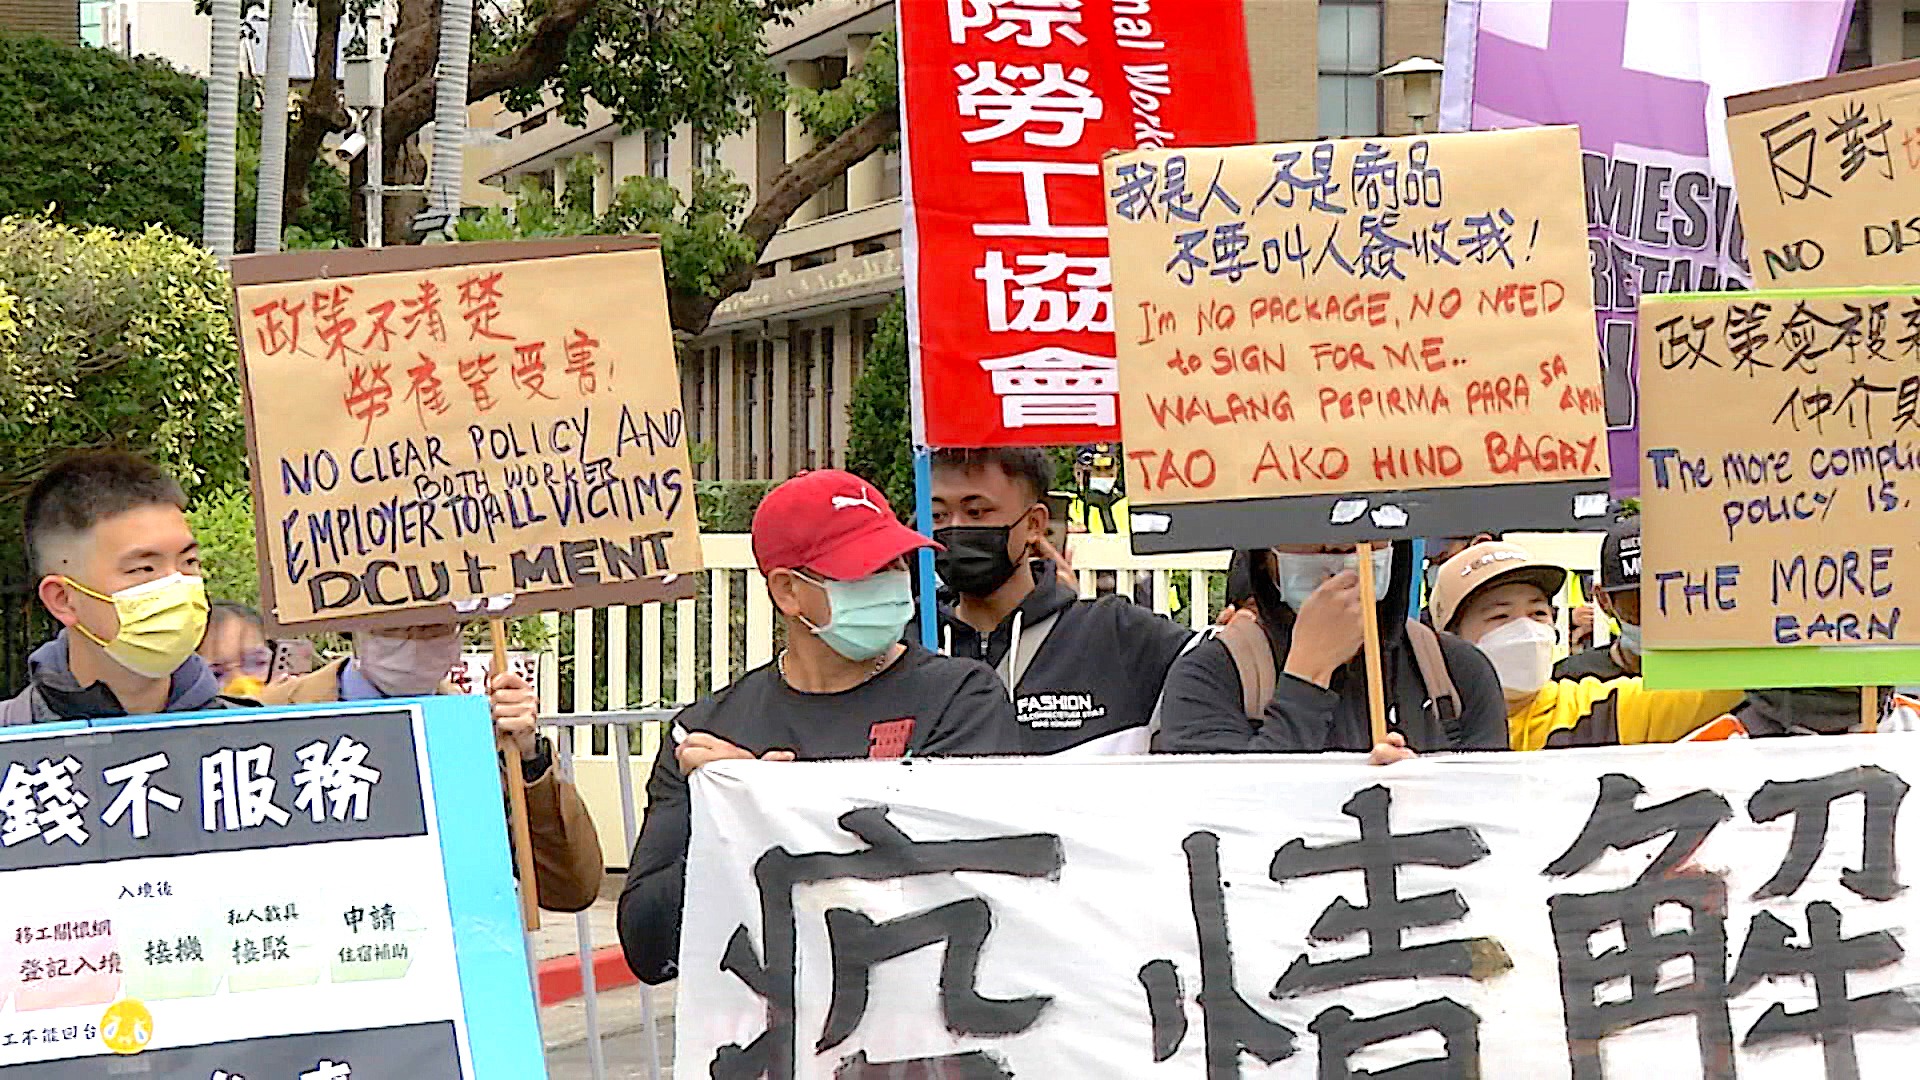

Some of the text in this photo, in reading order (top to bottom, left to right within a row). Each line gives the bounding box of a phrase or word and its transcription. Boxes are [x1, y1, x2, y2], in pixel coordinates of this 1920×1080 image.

[1763, 239, 1825, 280] NO
[251, 272, 515, 365] 政策不清楚
[1197, 299, 1236, 336] NO
[1411, 287, 1462, 321] NO
[1478, 279, 1565, 315] NEED
[1167, 348, 1201, 375] to
[1211, 344, 1286, 375] SIGN
[1310, 342, 1375, 372] FOR
[1146, 391, 1294, 430] WALANG
[1466, 372, 1529, 414] PARA
[1539, 354, 1568, 387] SA
[280, 404, 683, 496] NO CLEAR POLICY AND
[1128, 448, 1216, 491] TAO
[1253, 441, 1349, 484] AKO
[1373, 444, 1464, 481] HIND
[1647, 448, 1713, 491] The
[1810, 439, 1920, 483] compli
[281, 496, 444, 584] EMPLOYER
[548, 468, 684, 528] VICTIMS
[1655, 548, 1893, 617] THE MORE
[1775, 606, 1901, 645] EARN
[1016, 693, 1092, 714] FASHION
[0, 735, 381, 847] 錢不服務
[343, 903, 396, 934] 申請
[19, 951, 123, 982] 登記入境
[144, 935, 204, 965] 接機
